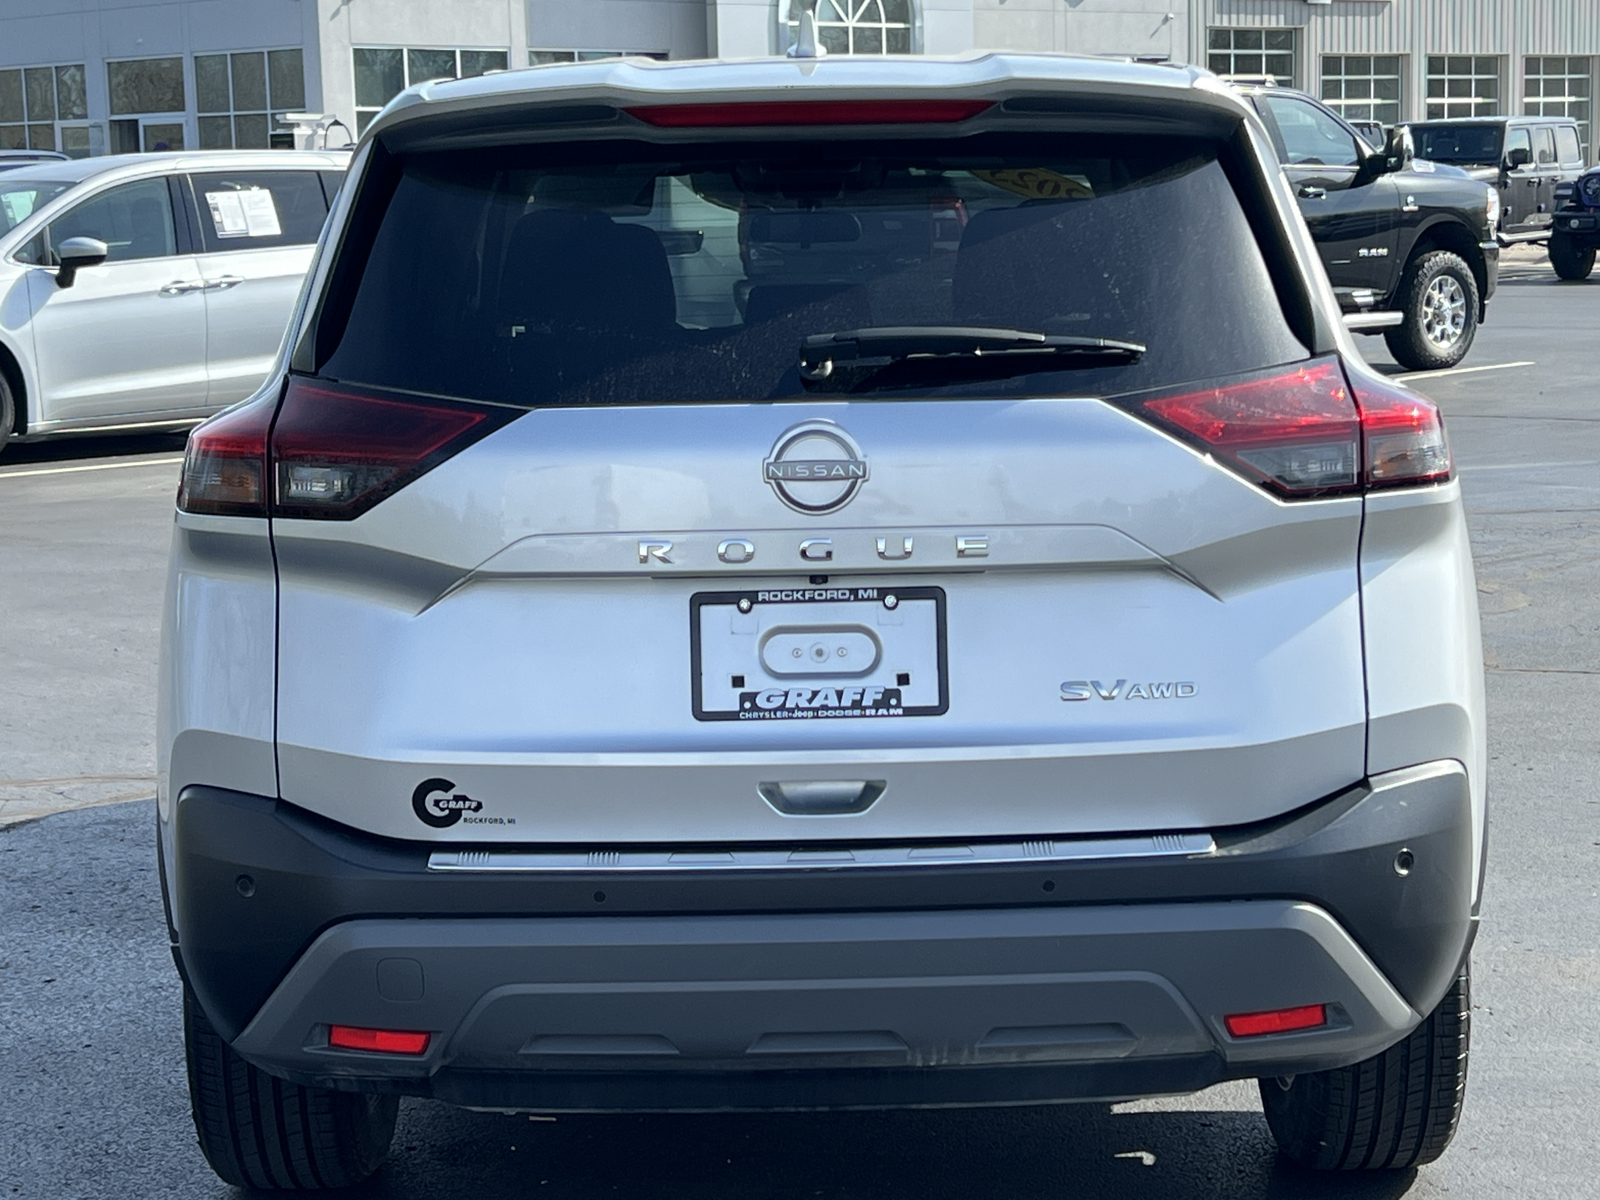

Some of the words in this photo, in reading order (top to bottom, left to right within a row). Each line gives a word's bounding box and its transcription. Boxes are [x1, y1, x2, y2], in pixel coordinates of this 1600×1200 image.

[1358, 248, 1388, 257] RAM
[768, 463, 865, 478] NISSAN
[637, 534, 990, 564] ROGUE
[758, 589, 854, 602] ROCKFORD,
[858, 589, 878, 600] MI
[755, 686, 886, 710] GRAFF
[439, 801, 478, 809] GRAFF
[463, 817, 506, 825] ROCKFORD,
